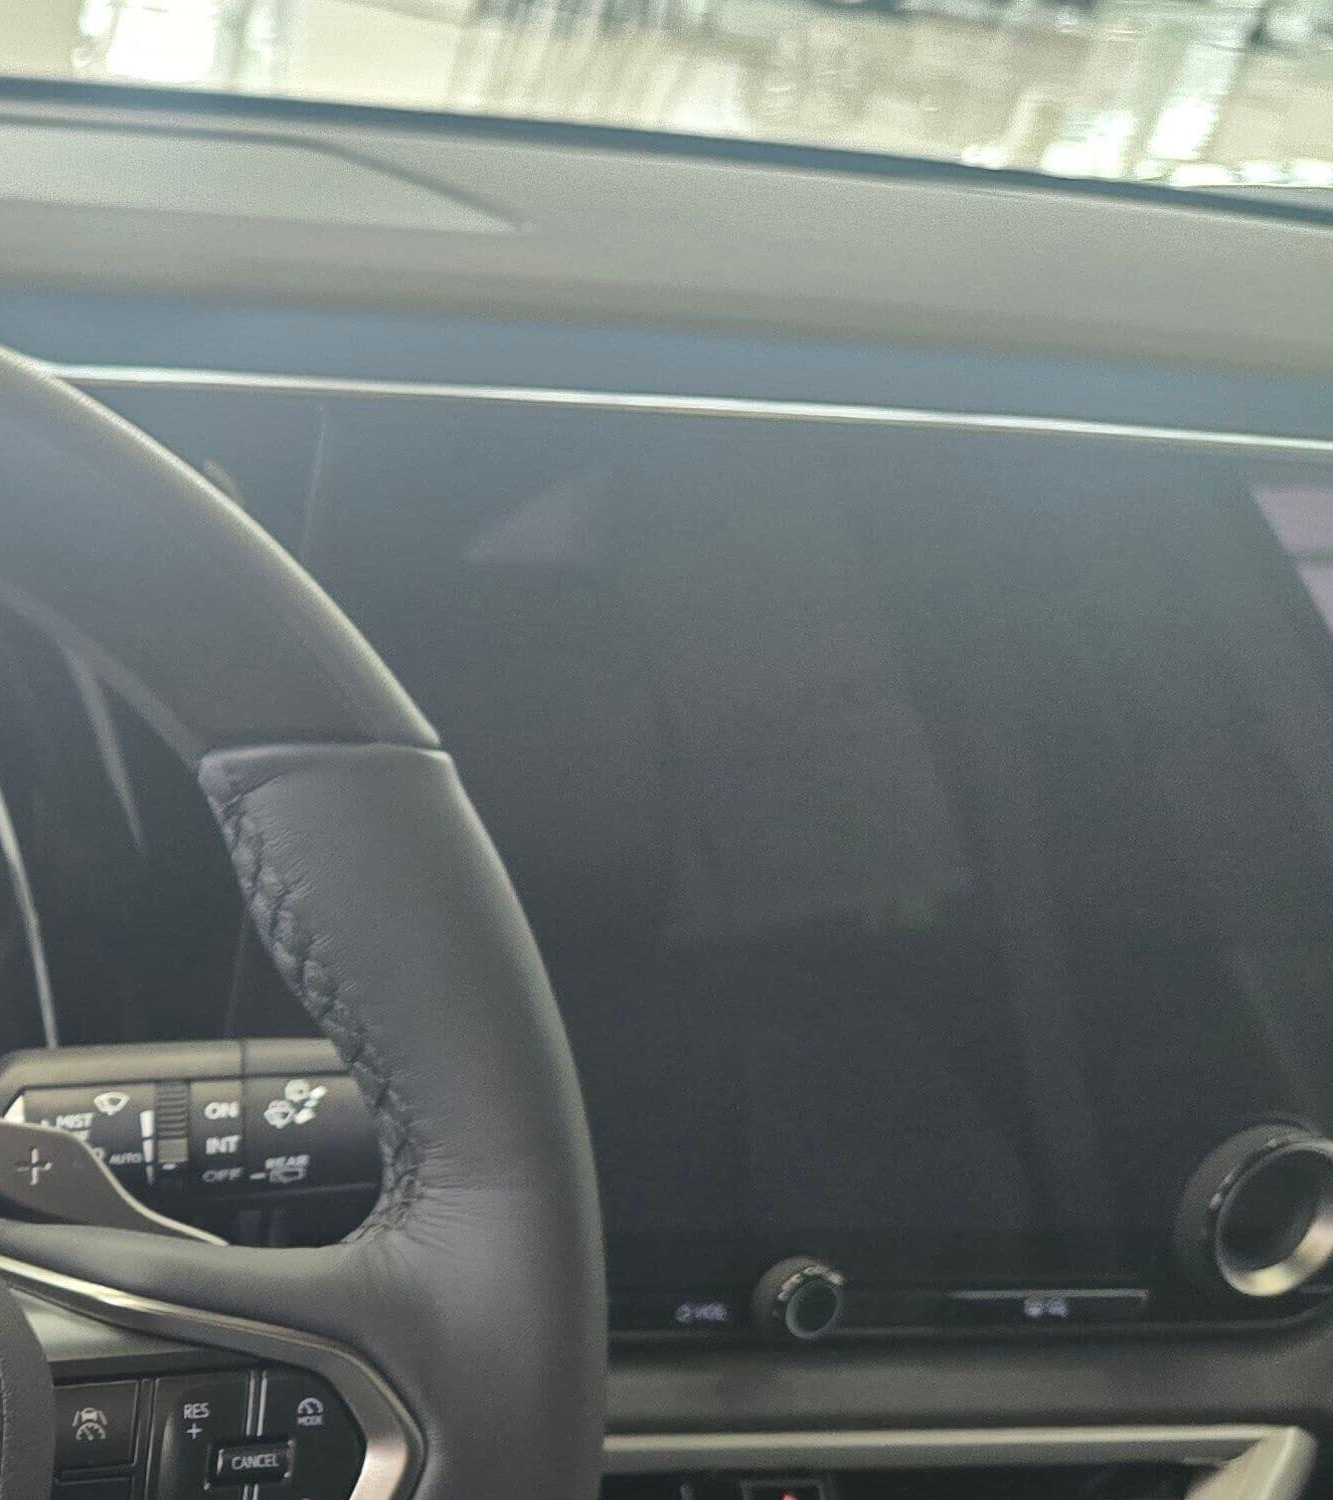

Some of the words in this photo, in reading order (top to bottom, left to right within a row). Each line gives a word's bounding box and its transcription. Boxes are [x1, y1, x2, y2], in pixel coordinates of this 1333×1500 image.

[203, 1101, 240, 1120] ON
[205, 1134, 241, 1155] INT
[183, 1402, 211, 1419] RES
[231, 1453, 280, 1470] CANCEL
